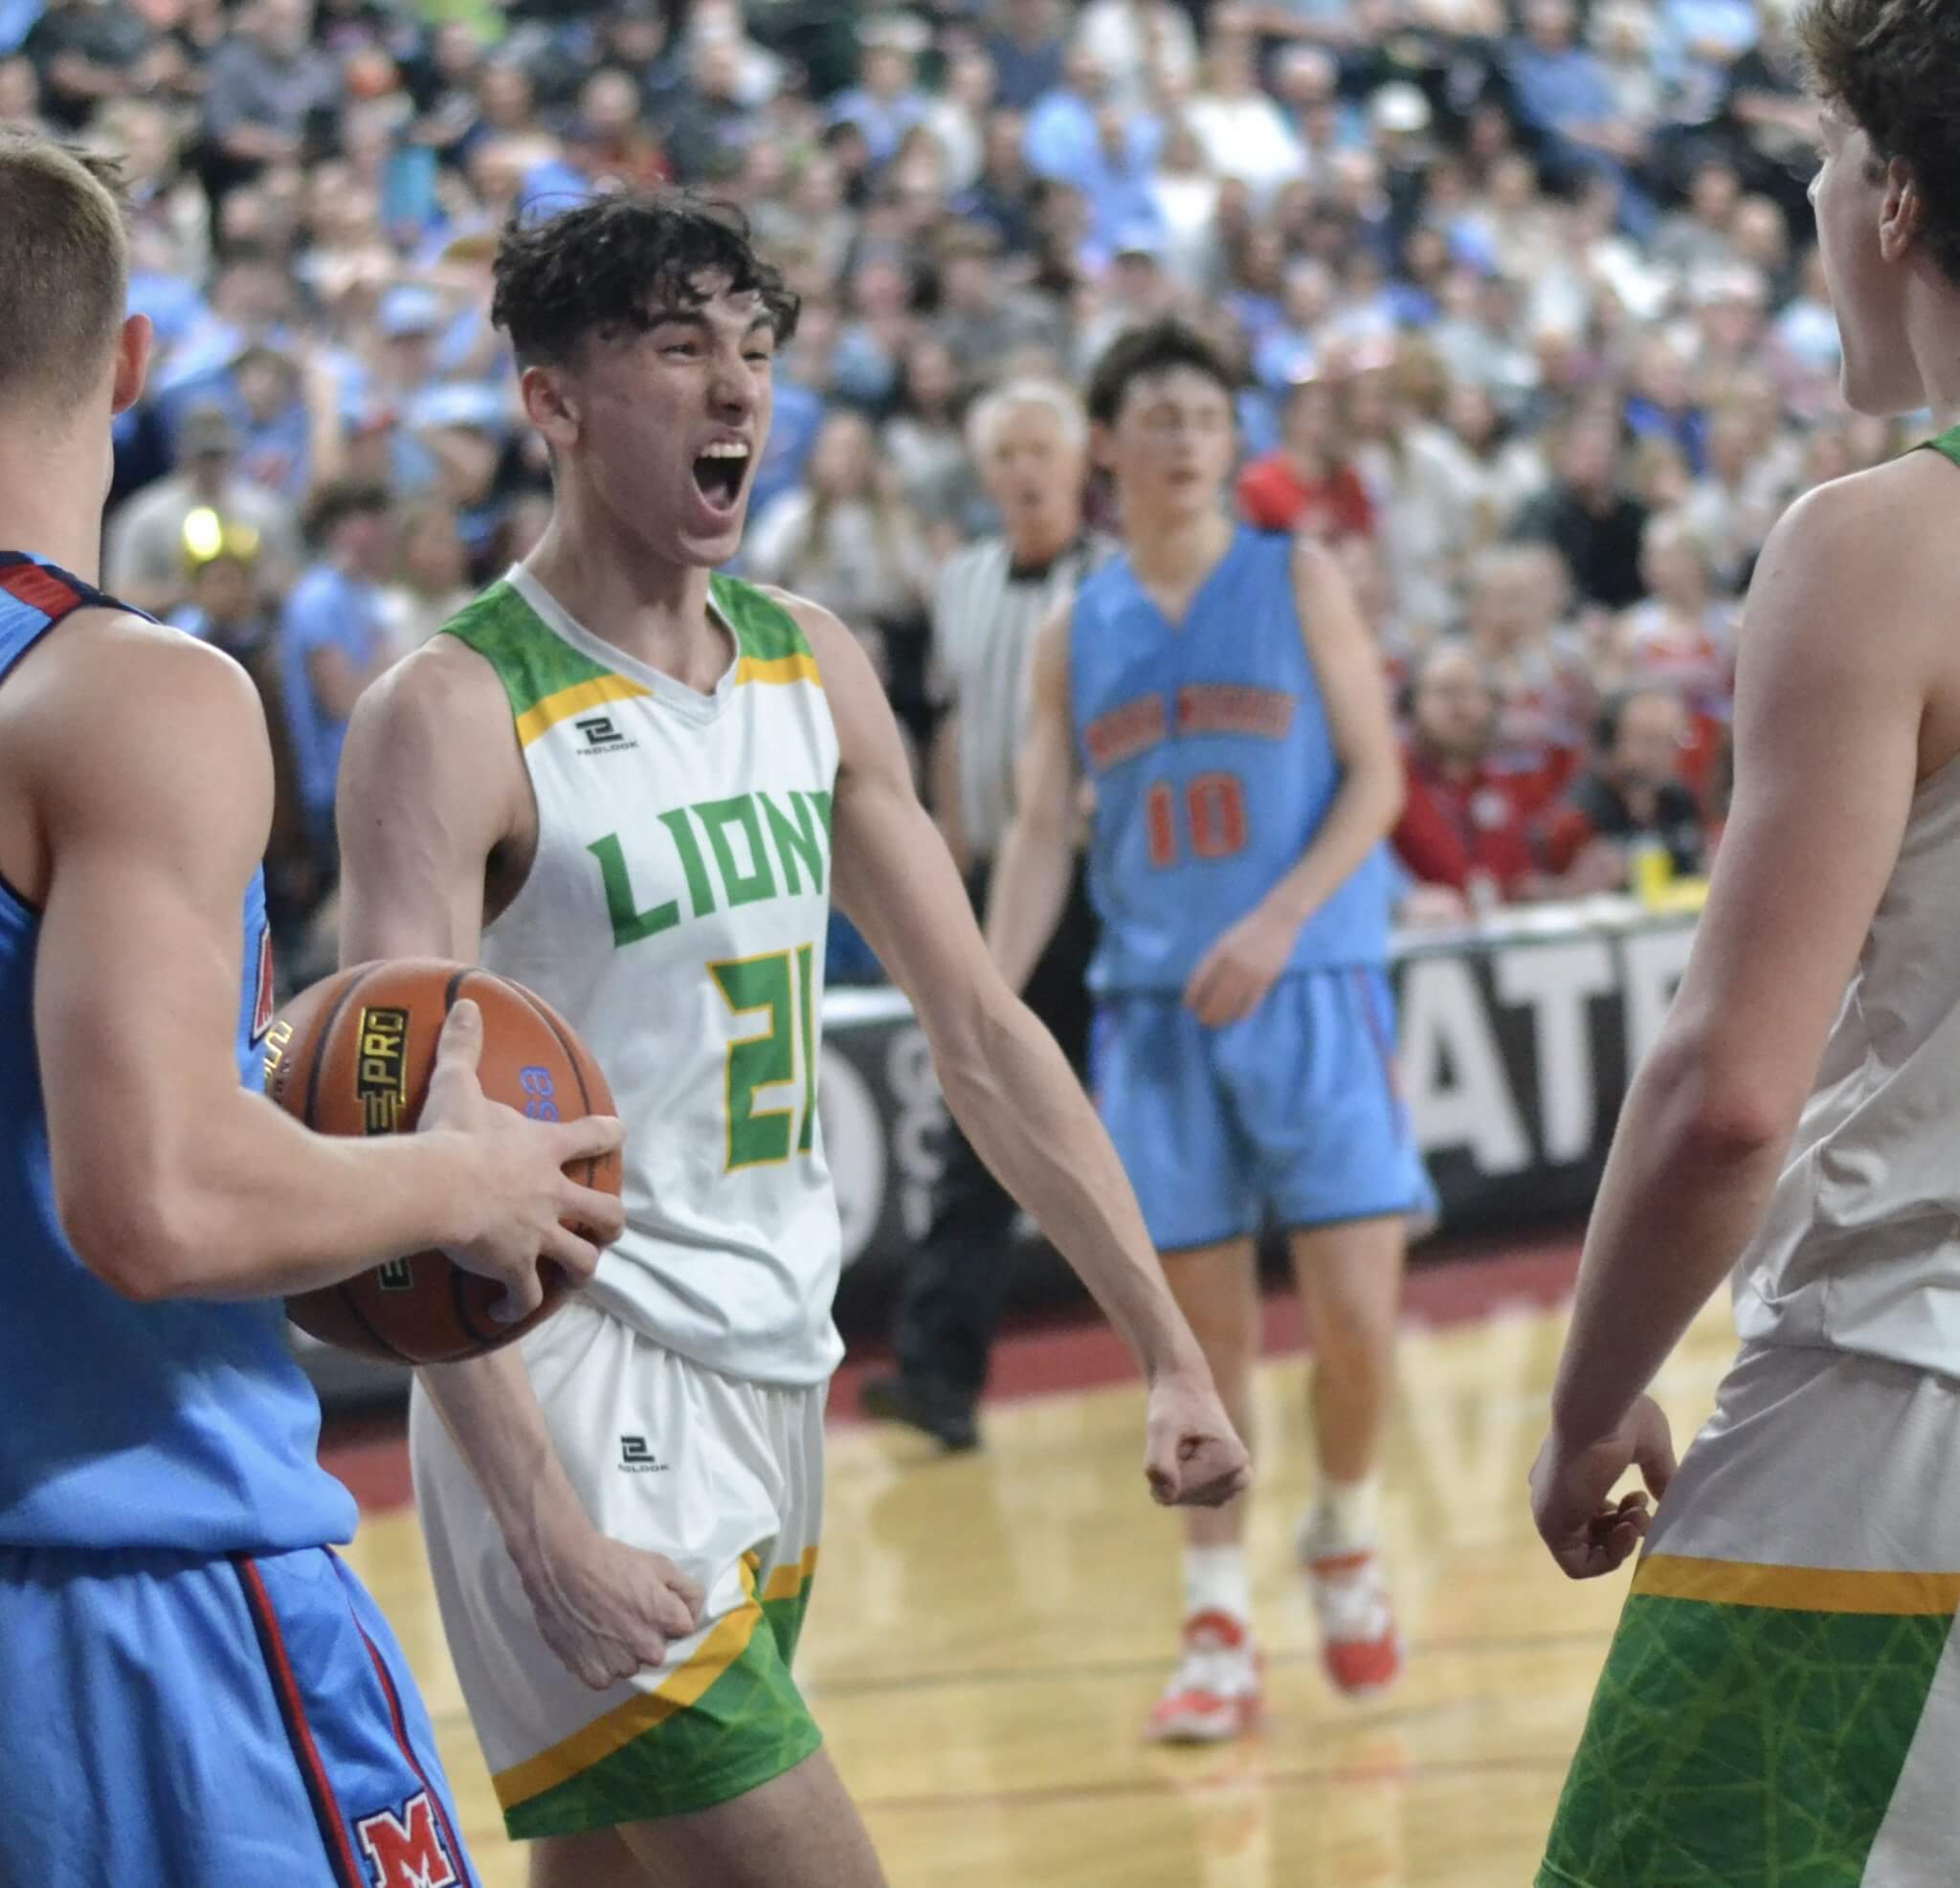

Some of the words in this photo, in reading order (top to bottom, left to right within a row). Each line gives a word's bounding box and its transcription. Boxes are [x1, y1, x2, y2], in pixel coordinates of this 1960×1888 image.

[1144, 773, 1248, 870] 10
[361, 1011, 404, 1085] PRO
[705, 942, 813, 1174] 21
[354, 1789, 457, 1888] M
